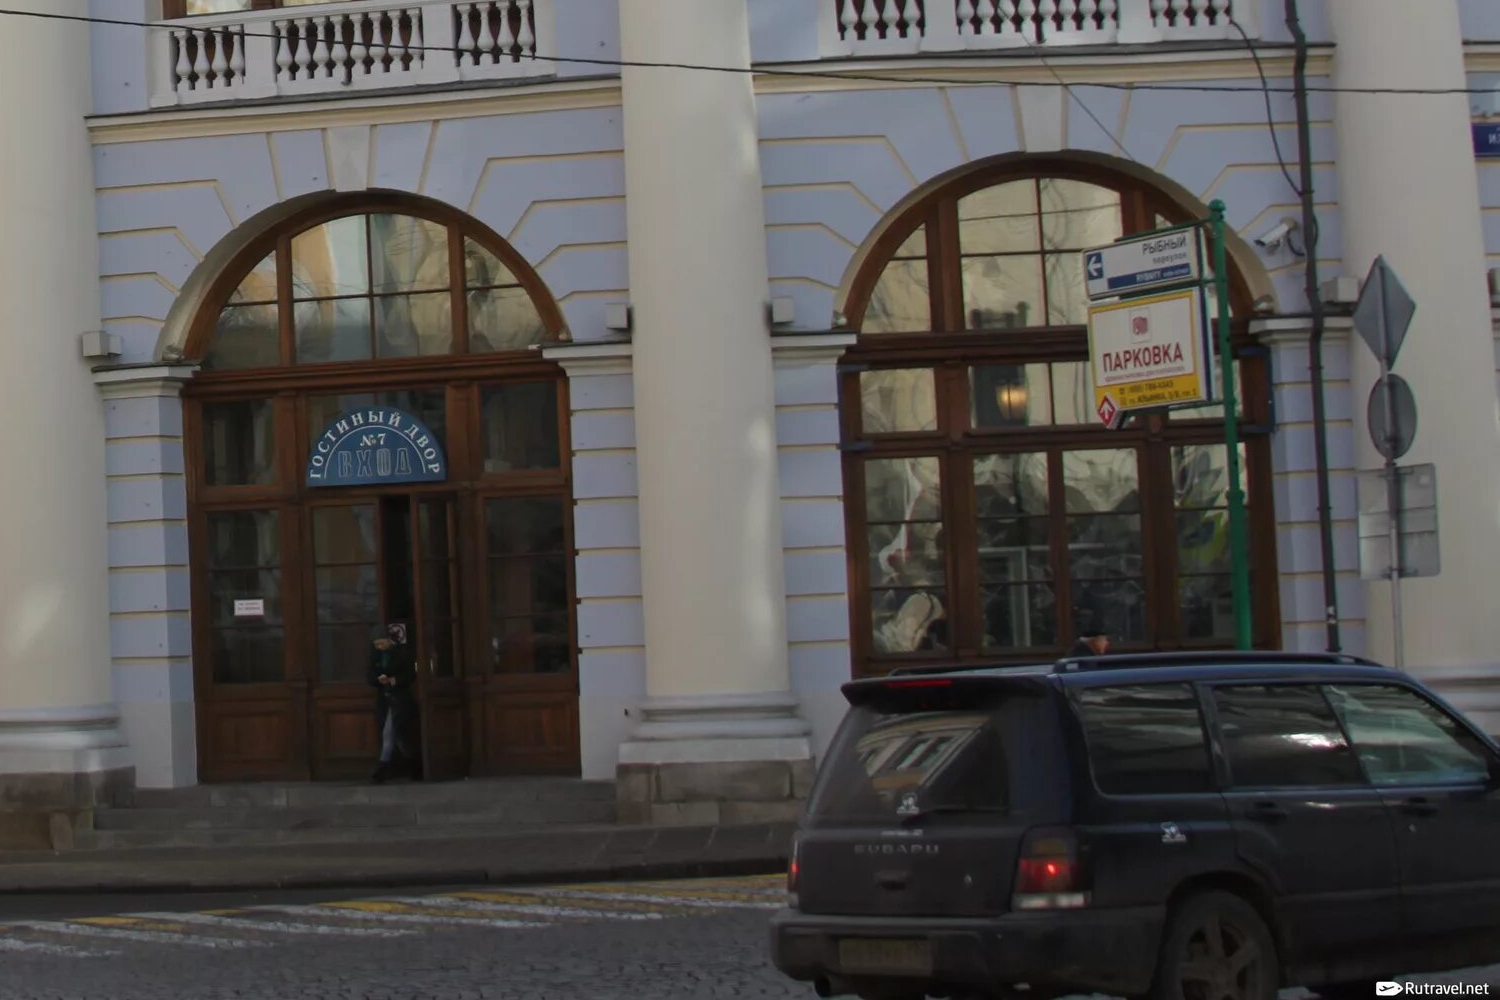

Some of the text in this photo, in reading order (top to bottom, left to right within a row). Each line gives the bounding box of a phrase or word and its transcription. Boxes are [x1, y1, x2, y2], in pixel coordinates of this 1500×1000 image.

[1142, 234, 1187, 255] РЫБНЫЙ
[1103, 342, 1184, 372] ПАРКОВКА
[310, 411, 441, 479] ГОСТИНЫЙ ДВОР
[338, 448, 411, 478] ВХОД
